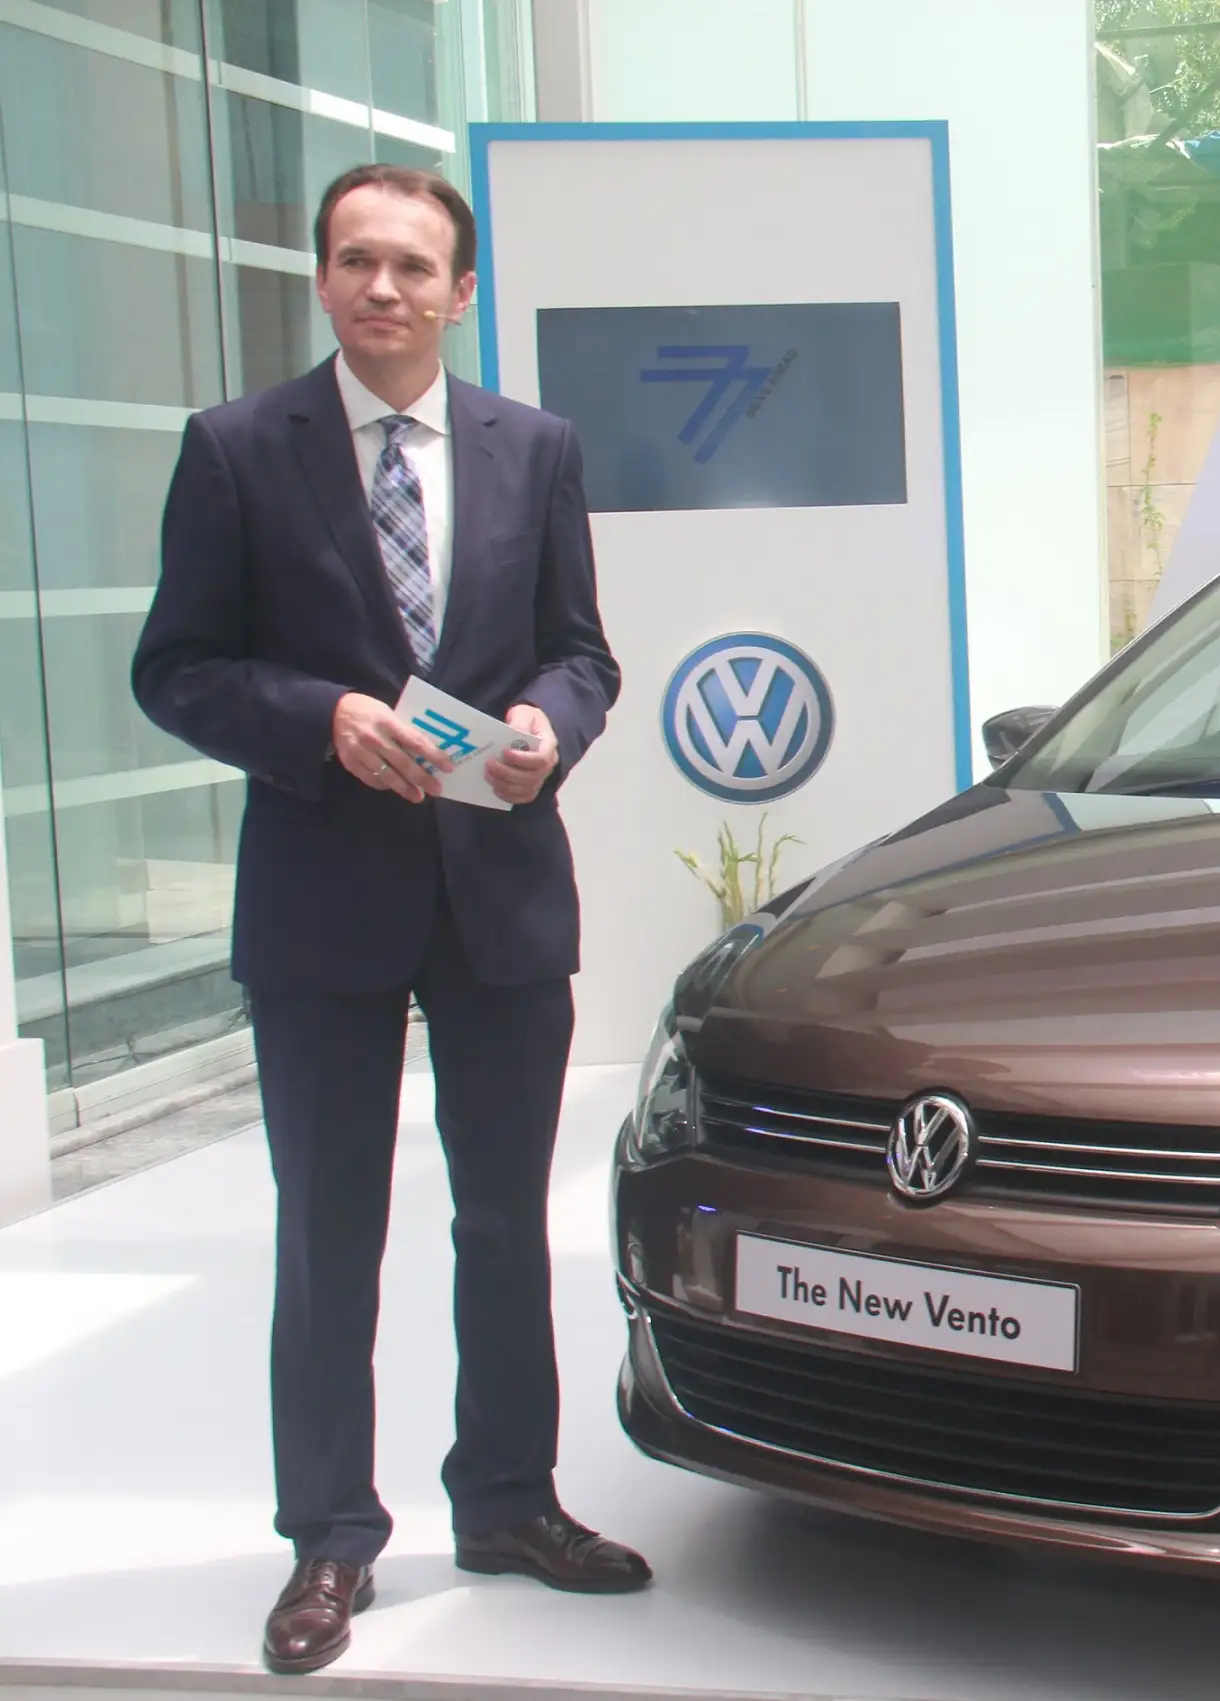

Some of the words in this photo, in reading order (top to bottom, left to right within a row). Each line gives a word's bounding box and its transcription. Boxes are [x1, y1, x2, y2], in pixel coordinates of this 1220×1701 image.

[777, 1265, 827, 1307] The
[839, 1276, 913, 1322] New
[924, 1291, 1021, 1340] Vento
